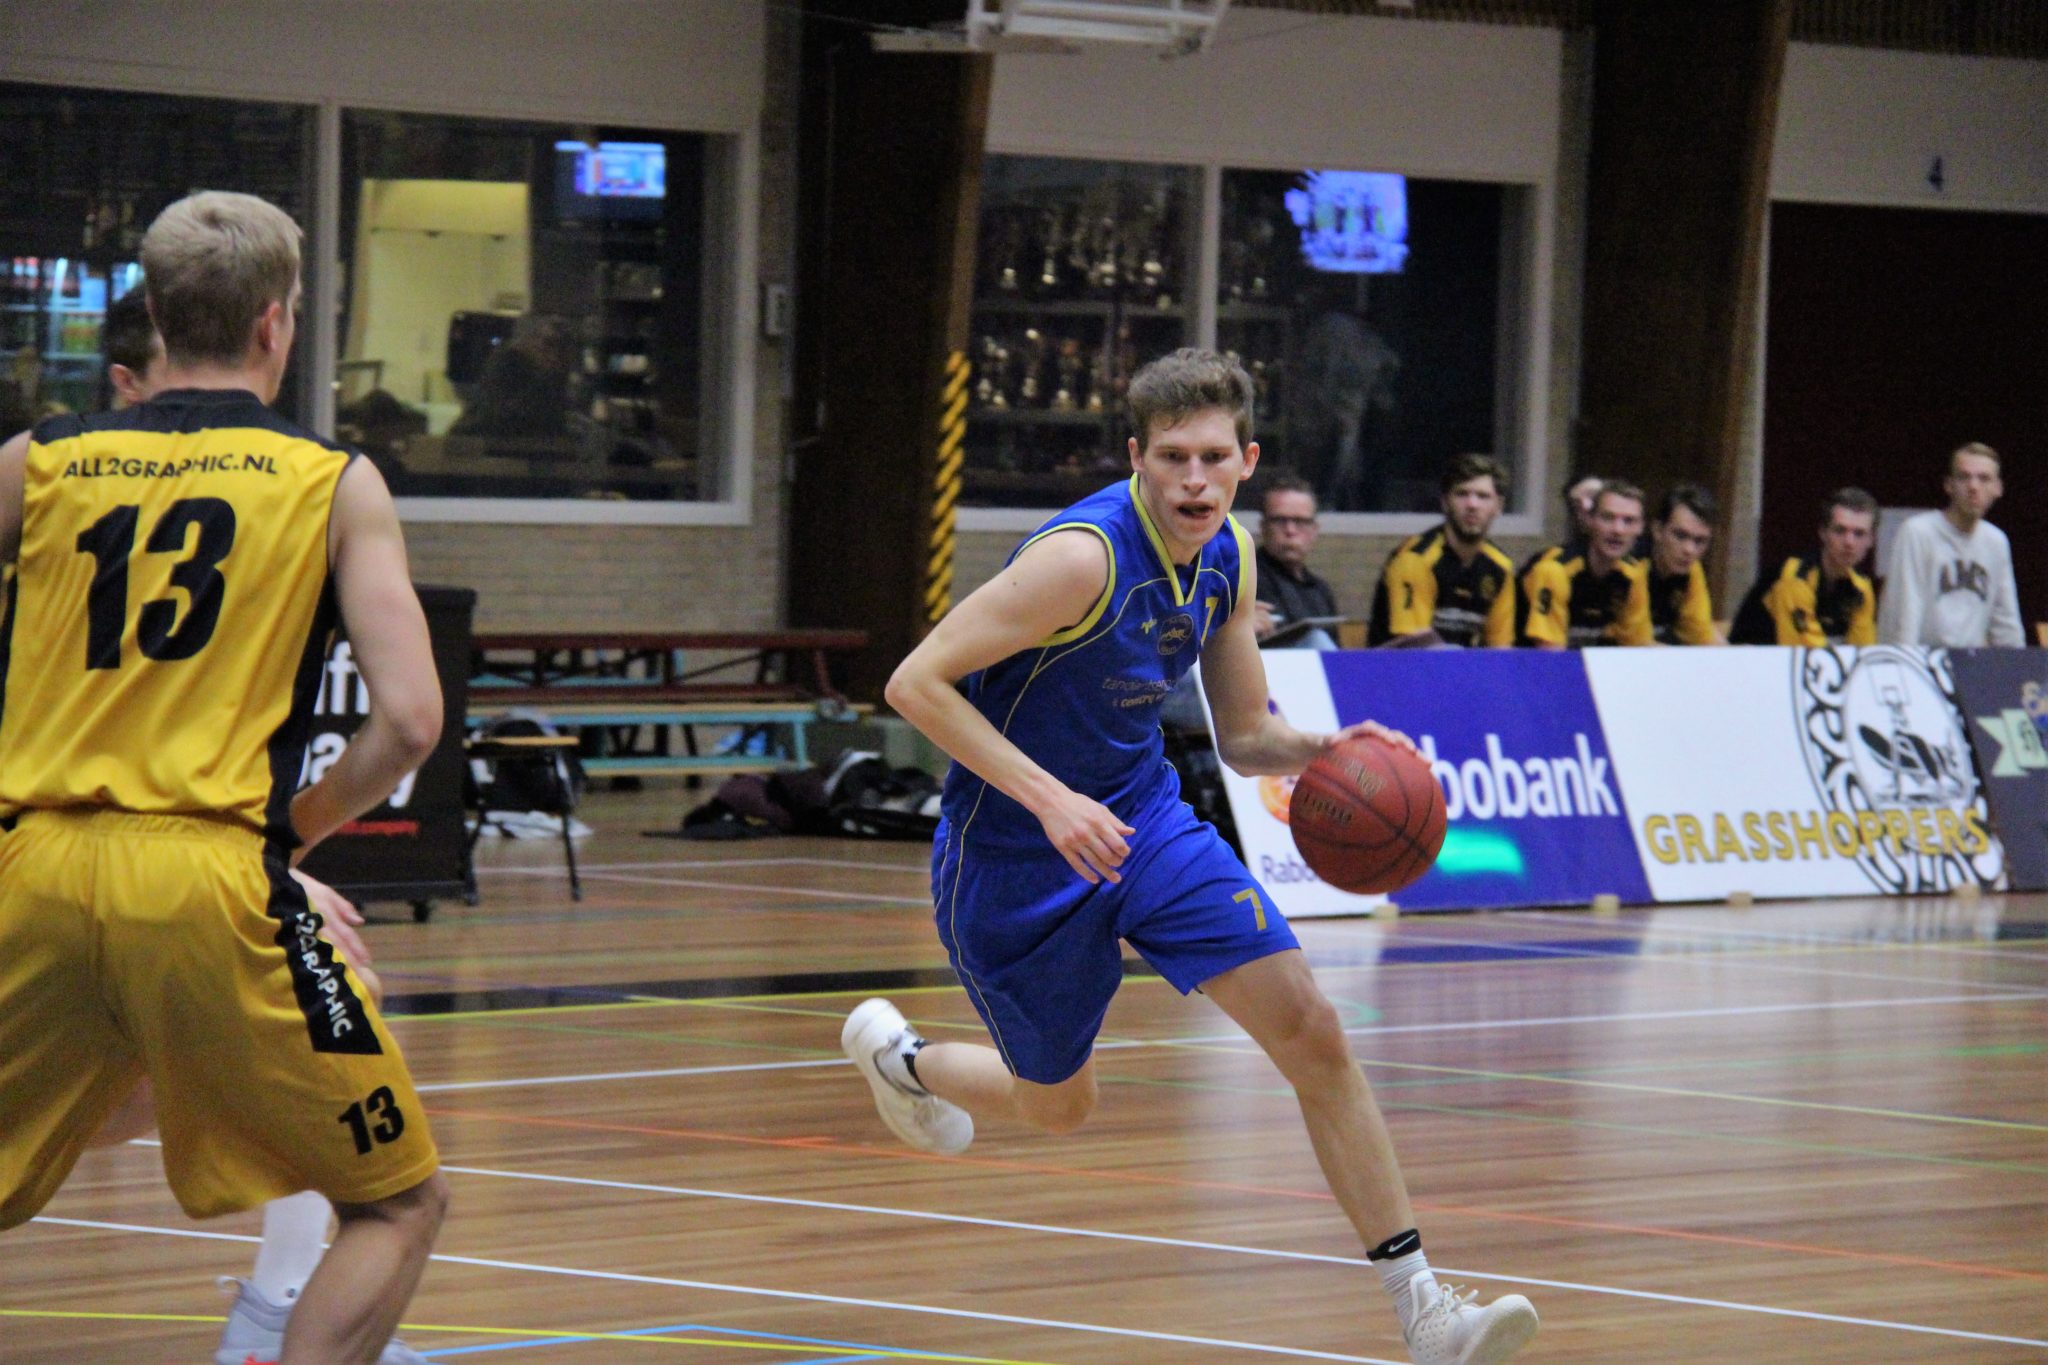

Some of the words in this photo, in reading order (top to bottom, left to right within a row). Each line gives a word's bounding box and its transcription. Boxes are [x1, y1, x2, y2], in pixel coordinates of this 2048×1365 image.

[62, 452, 279, 480] ALL2GRAPHIC.NL
[76, 497, 237, 670] 13
[1420, 733, 1620, 820] bobank
[1643, 808, 1990, 865] GRASSHOPPERS
[1261, 853, 1320, 884] Rabo
[1232, 887, 1267, 931] 7
[338, 1086, 405, 1155] 13
